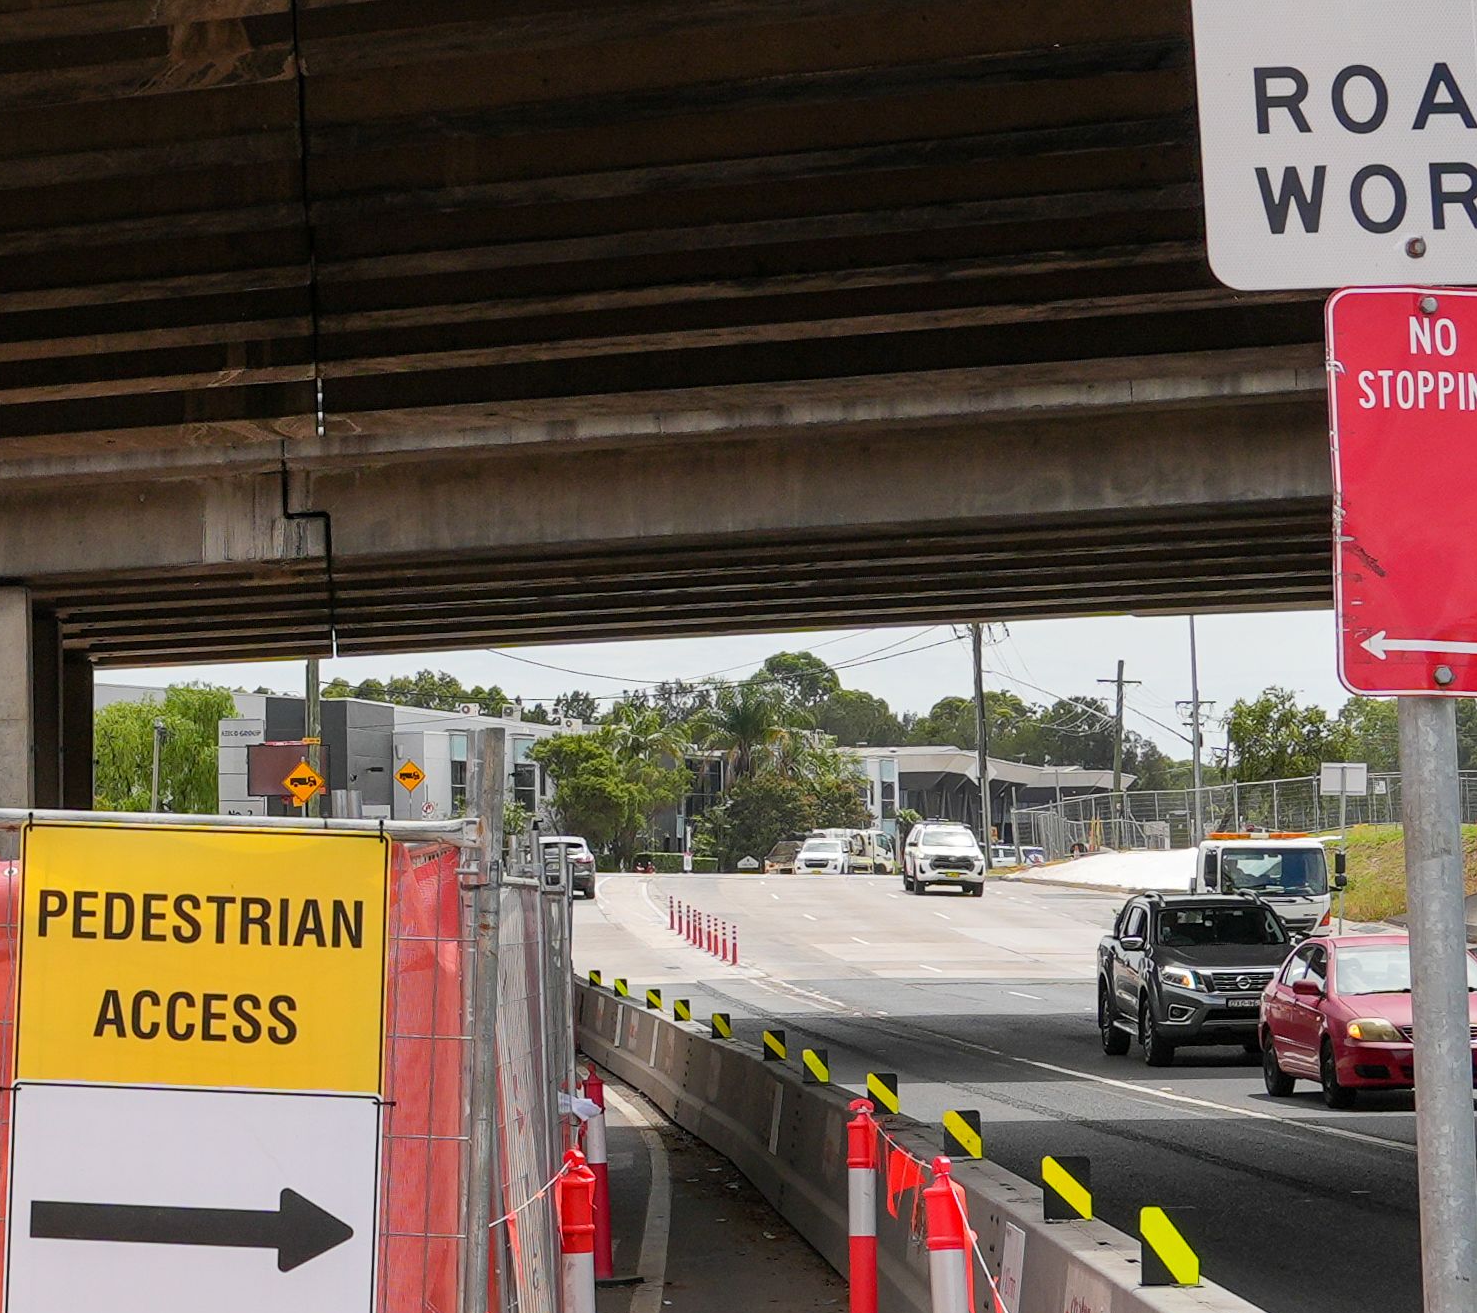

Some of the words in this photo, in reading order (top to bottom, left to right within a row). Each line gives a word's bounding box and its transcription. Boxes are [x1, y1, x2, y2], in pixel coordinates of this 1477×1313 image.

[1409, 317, 1456, 357] NO
[38, 888, 365, 951] PEDESTRIAN
[94, 988, 297, 1046] ACCESS
